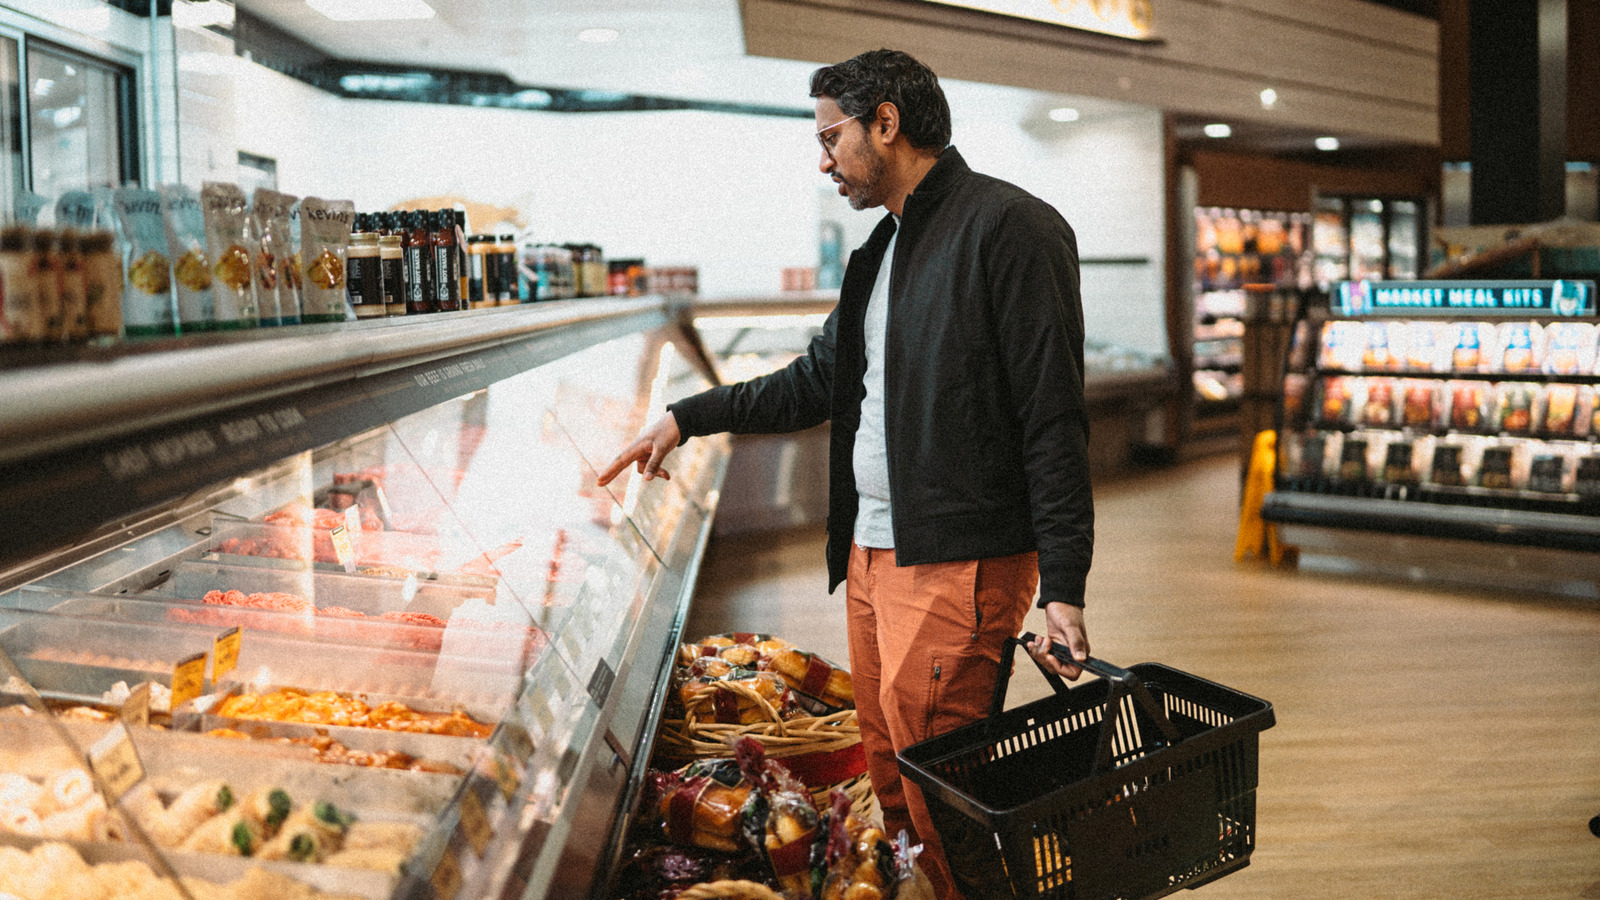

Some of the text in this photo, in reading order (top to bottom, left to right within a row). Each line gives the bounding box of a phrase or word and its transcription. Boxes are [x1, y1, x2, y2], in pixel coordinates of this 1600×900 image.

[1376, 288, 1543, 307] MARKET MEAL KITS
